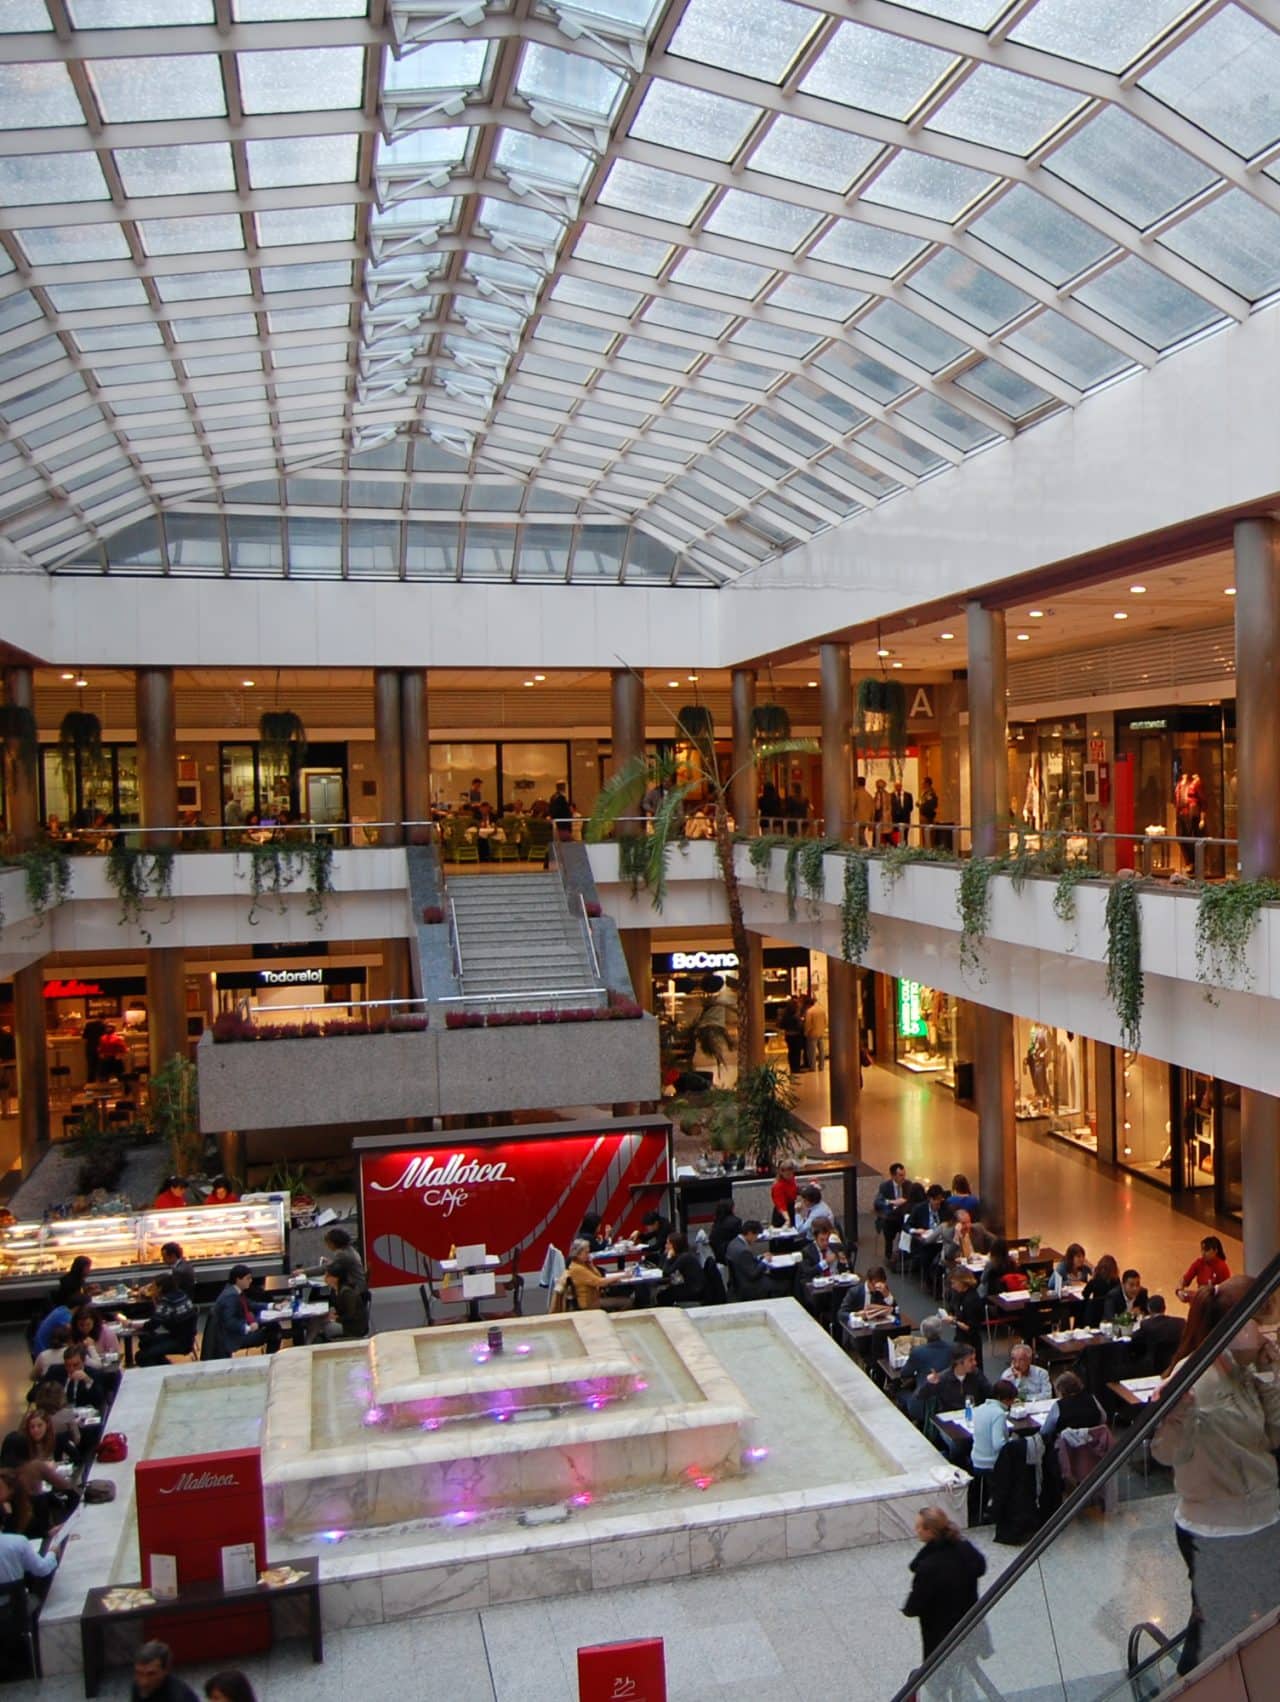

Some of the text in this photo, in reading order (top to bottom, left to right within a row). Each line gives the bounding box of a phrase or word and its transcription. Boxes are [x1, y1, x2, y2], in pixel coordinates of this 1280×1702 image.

[261, 969, 323, 983] Todoreloj
[370, 1153, 515, 1191] Mallorca
[159, 1472, 240, 1494] Mallorca
